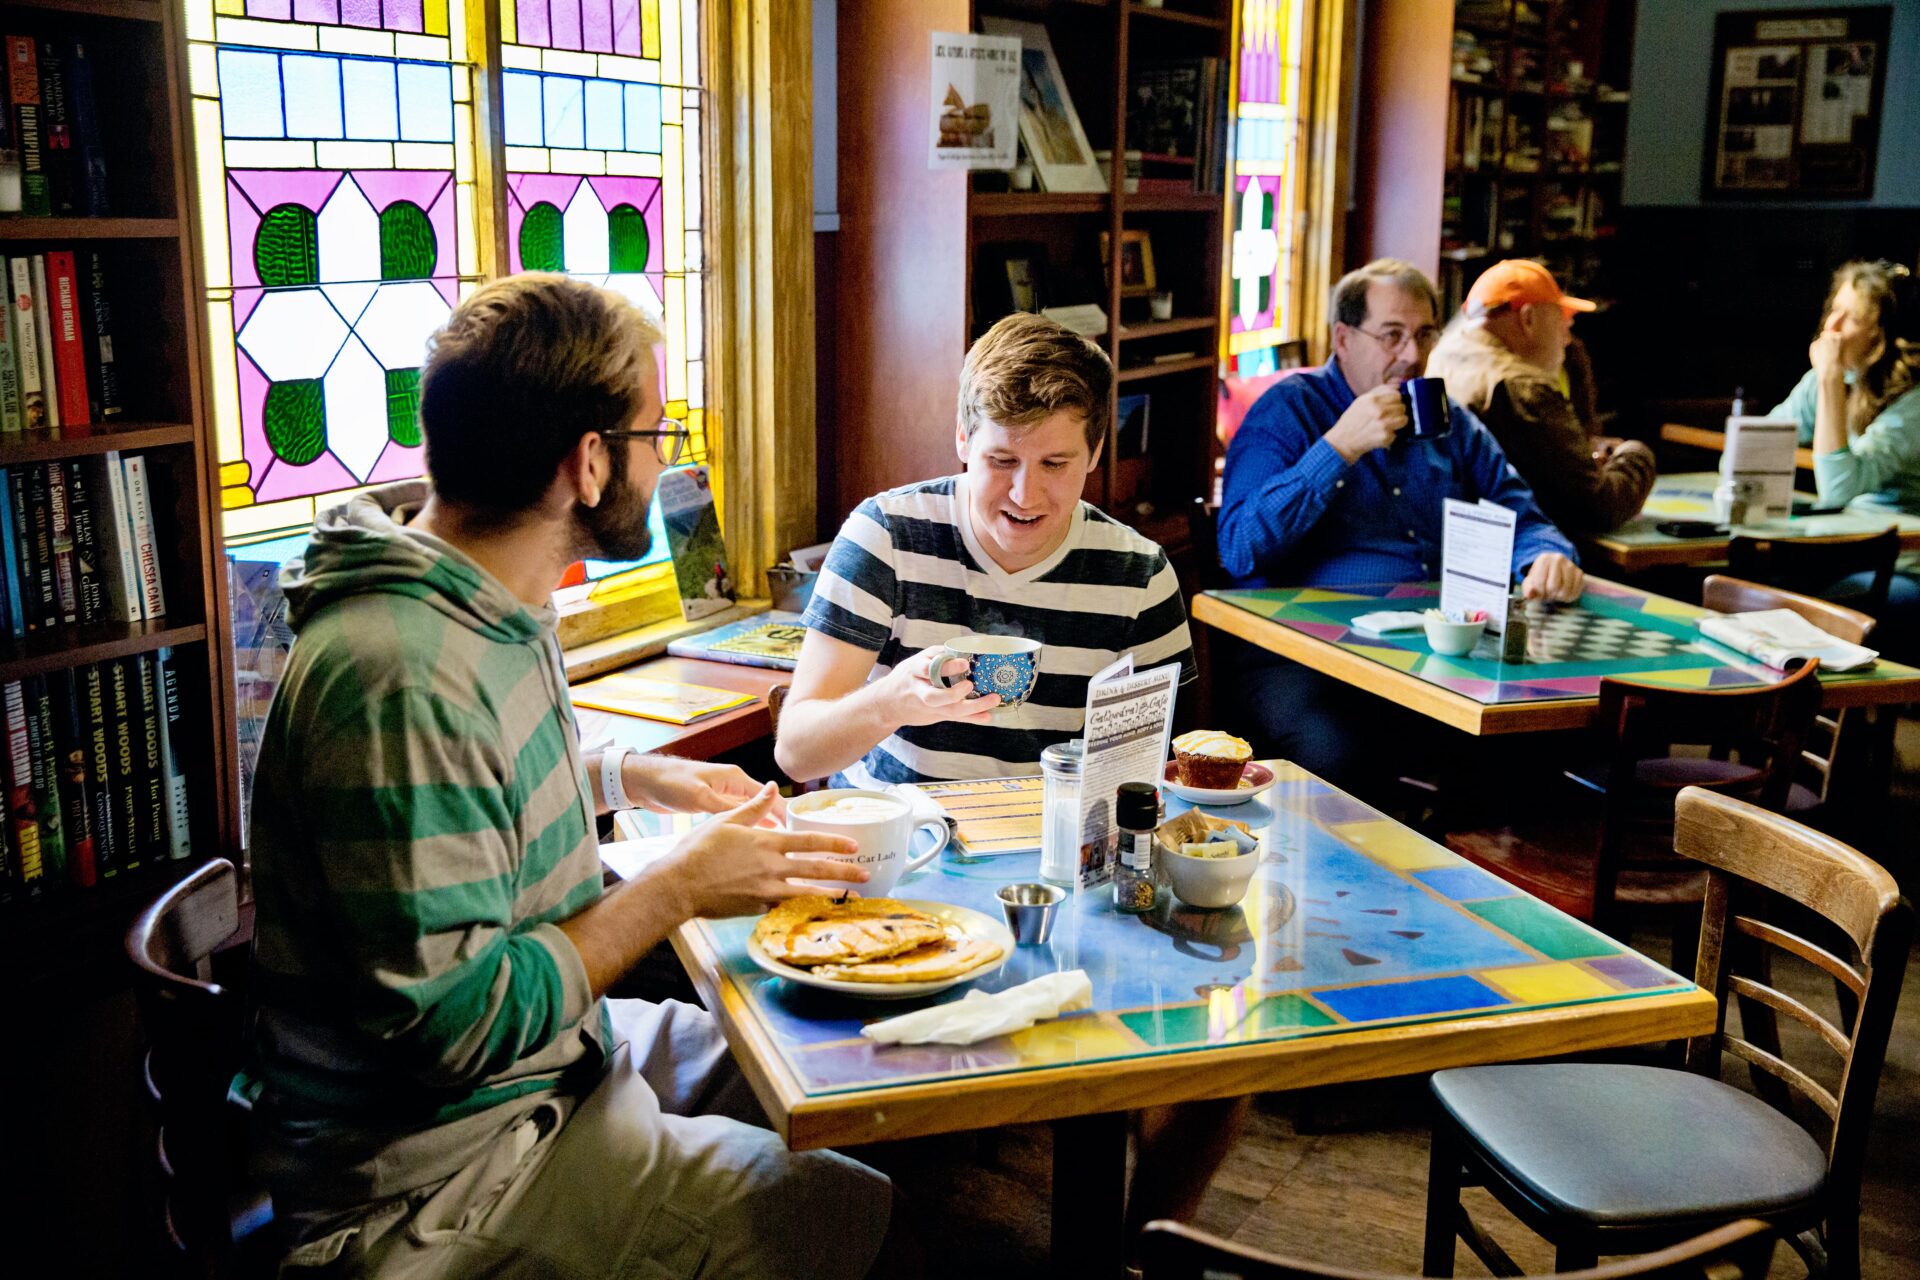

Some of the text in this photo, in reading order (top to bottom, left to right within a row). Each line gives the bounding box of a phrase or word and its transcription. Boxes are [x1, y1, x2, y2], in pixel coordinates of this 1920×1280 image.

[53, 73, 65, 121] BARBARA
[20, 105, 41, 171] REDEMPTION
[58, 276, 76, 341] RICHARD HERMAN
[92, 291, 105, 334] JACKSON
[28, 351, 36, 379] Jordan
[48, 463, 66, 532] JOHN SANDFORD
[137, 501, 145, 520] KICK
[81, 508, 93, 545] THE LAST
[60, 557, 76, 612] MAD RIVER
[81, 575, 93, 620] GRISHAM
[90, 582, 101, 609] JOHN
[141, 543, 162, 613] CHELSEA CAIN
[165, 670, 180, 722] AGENDA
[1096, 686, 1118, 697] DRINK
[1127, 681, 1152, 691] DESSERT
[3, 680, 33, 787] JONATHAN KELLERMAN
[28, 715, 41, 748] DAMNED
[39, 696, 52, 737] Robert
[88, 670, 108, 783] STUART WOODS
[112, 664, 132, 776] STUART WOODS
[142, 660, 159, 769] STUART WOODS
[33, 760, 43, 776] YOU
[35, 778, 45, 789] DO
[96, 792, 109, 861] CONSEQUENCES
[150, 778, 161, 840] Hot Pursuit
[19, 823, 43, 882] GONE
[857, 854, 875, 864] Cat
[878, 850, 896, 863] Lady
